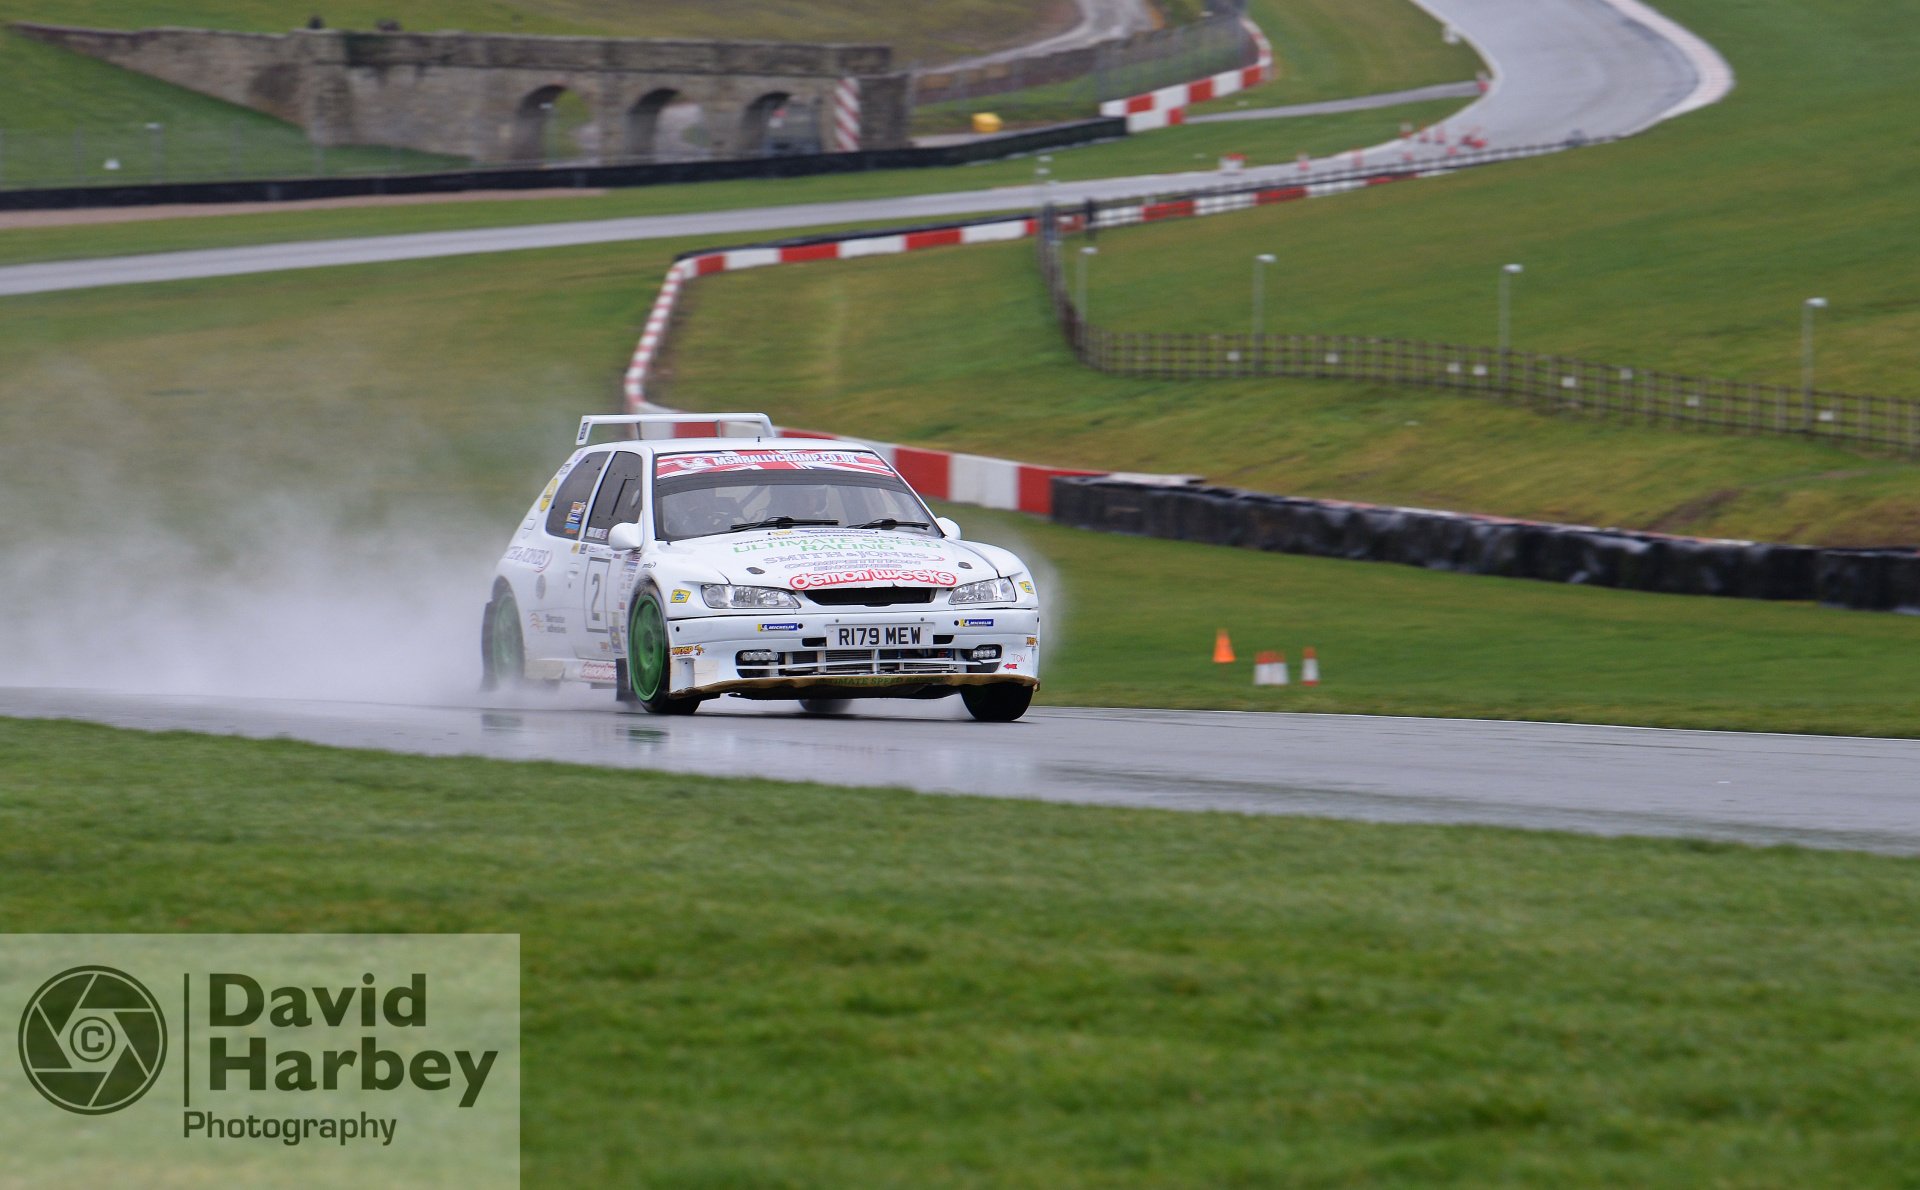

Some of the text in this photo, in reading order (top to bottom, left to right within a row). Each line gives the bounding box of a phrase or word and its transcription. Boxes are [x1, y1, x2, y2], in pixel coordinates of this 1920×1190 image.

[734, 537, 851, 553] ULTIMATE
[862, 537, 942, 549] SPEED
[801, 543, 894, 552] RACING
[763, 552, 842, 564] SMITH
[857, 551, 929, 559] JONES
[591, 573, 601, 621] 2
[839, 627, 921, 645] R179 MEW
[671, 646, 694, 655] WOSP
[1011, 654, 1026, 662] TOW
